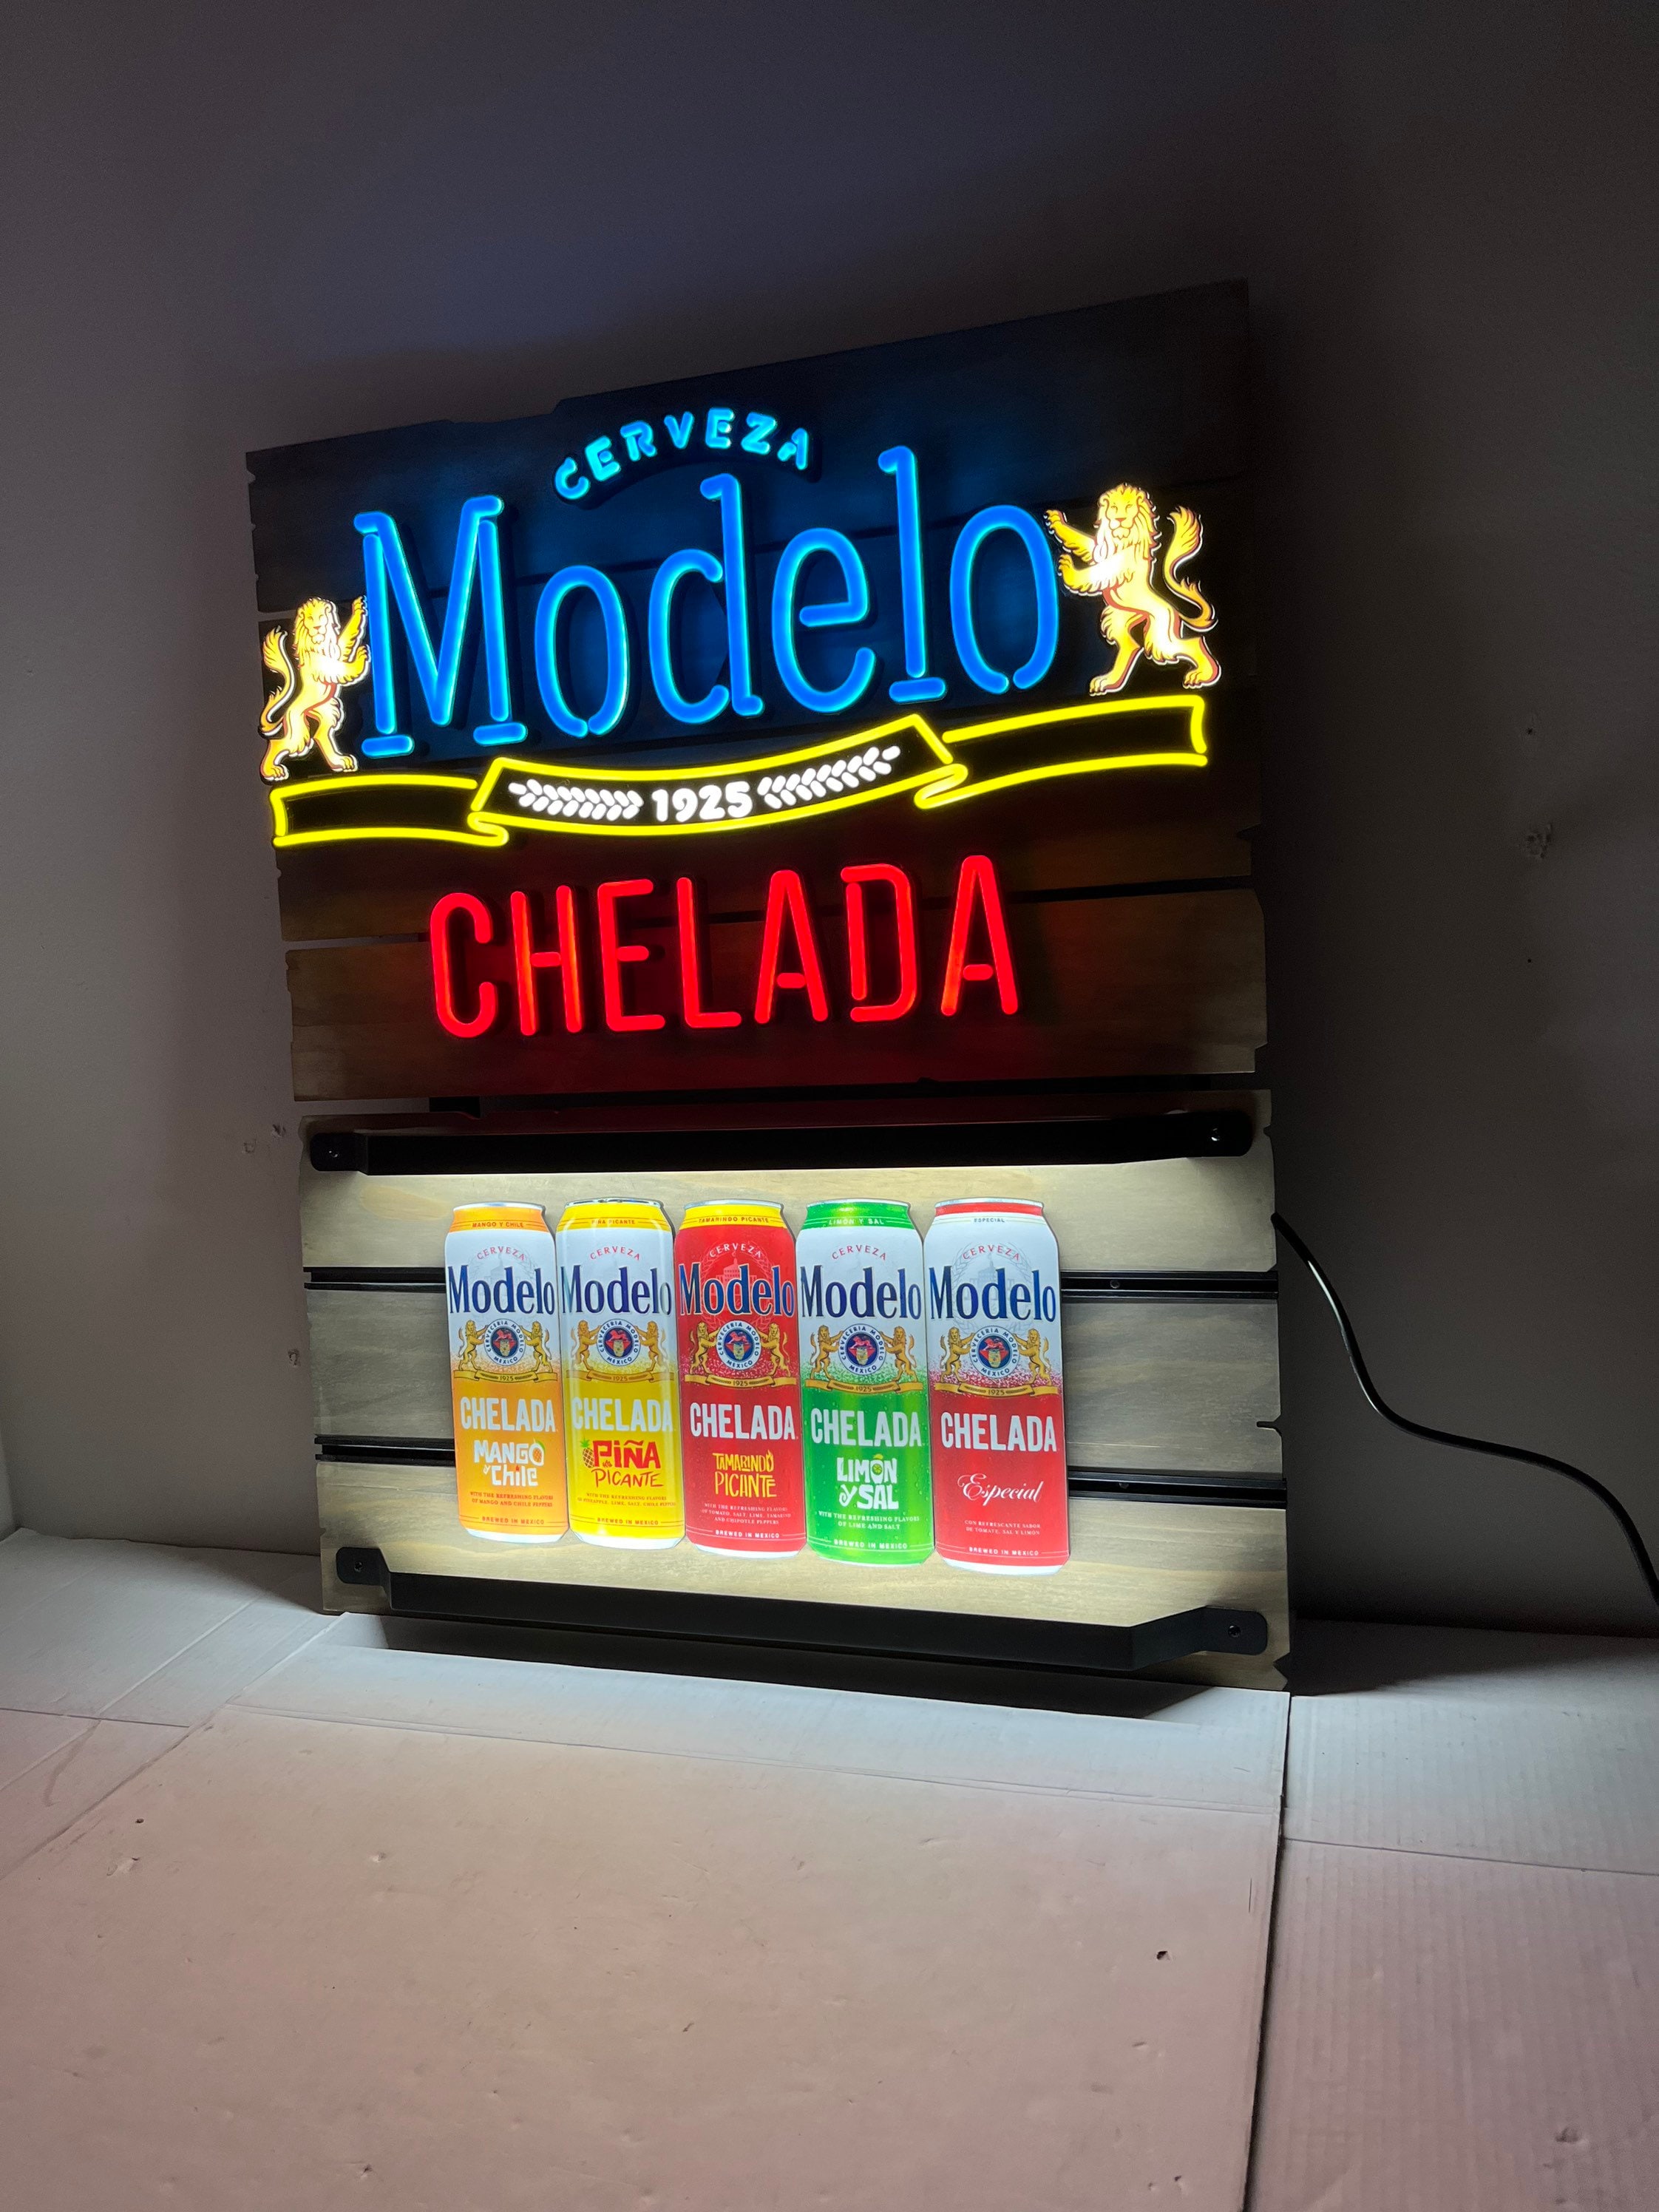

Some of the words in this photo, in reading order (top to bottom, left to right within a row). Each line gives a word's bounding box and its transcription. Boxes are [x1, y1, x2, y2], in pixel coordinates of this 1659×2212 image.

[555, 408, 808, 499] CERVEZA
[354, 446, 1059, 757] Modelo
[652, 785, 753, 822] 1925
[431, 855, 1018, 1037] CHELADA
[477, 1246, 526, 1261] CERVEZA
[590, 1246, 640, 1261] CERVEZA
[710, 1243, 761, 1258] CERVEZA
[832, 1245, 886, 1261] CERVEZA
[963, 1244, 1020, 1261] CERVEZA
[448, 1265, 554, 1314] Modelo
[561, 1264, 671, 1315] Modelo
[679, 1262, 794, 1317] Modelo
[801, 1264, 921, 1320] Modelo
[929, 1265, 1056, 1322] Modelo
[511, 1324, 523, 1353] MODELO
[625, 1324, 639, 1353] MODELO
[746, 1326, 760, 1356] MODELO
[869, 1330, 884, 1360] MODELO
[1002, 1331, 1017, 1364] MODELO
[460, 1397, 556, 1432] CHELADA
[571, 1397, 673, 1432] CHELADA
[690, 1402, 795, 1440] CHELADA
[810, 1408, 922, 1447] CHELADA
[940, 1412, 1056, 1452] CHELADA
[473, 1439, 545, 1466] MANGO
[592, 1439, 661, 1470] PIÑA
[591, 1468, 664, 1488] PICANTE
[715, 1471, 777, 1498] PICANTE
[957, 1473, 1044, 1506] Especial
[857, 1485, 899, 1510] SAL
[834, 1538, 864, 1547] BREWED
[969, 1547, 998, 1555] BREWED
